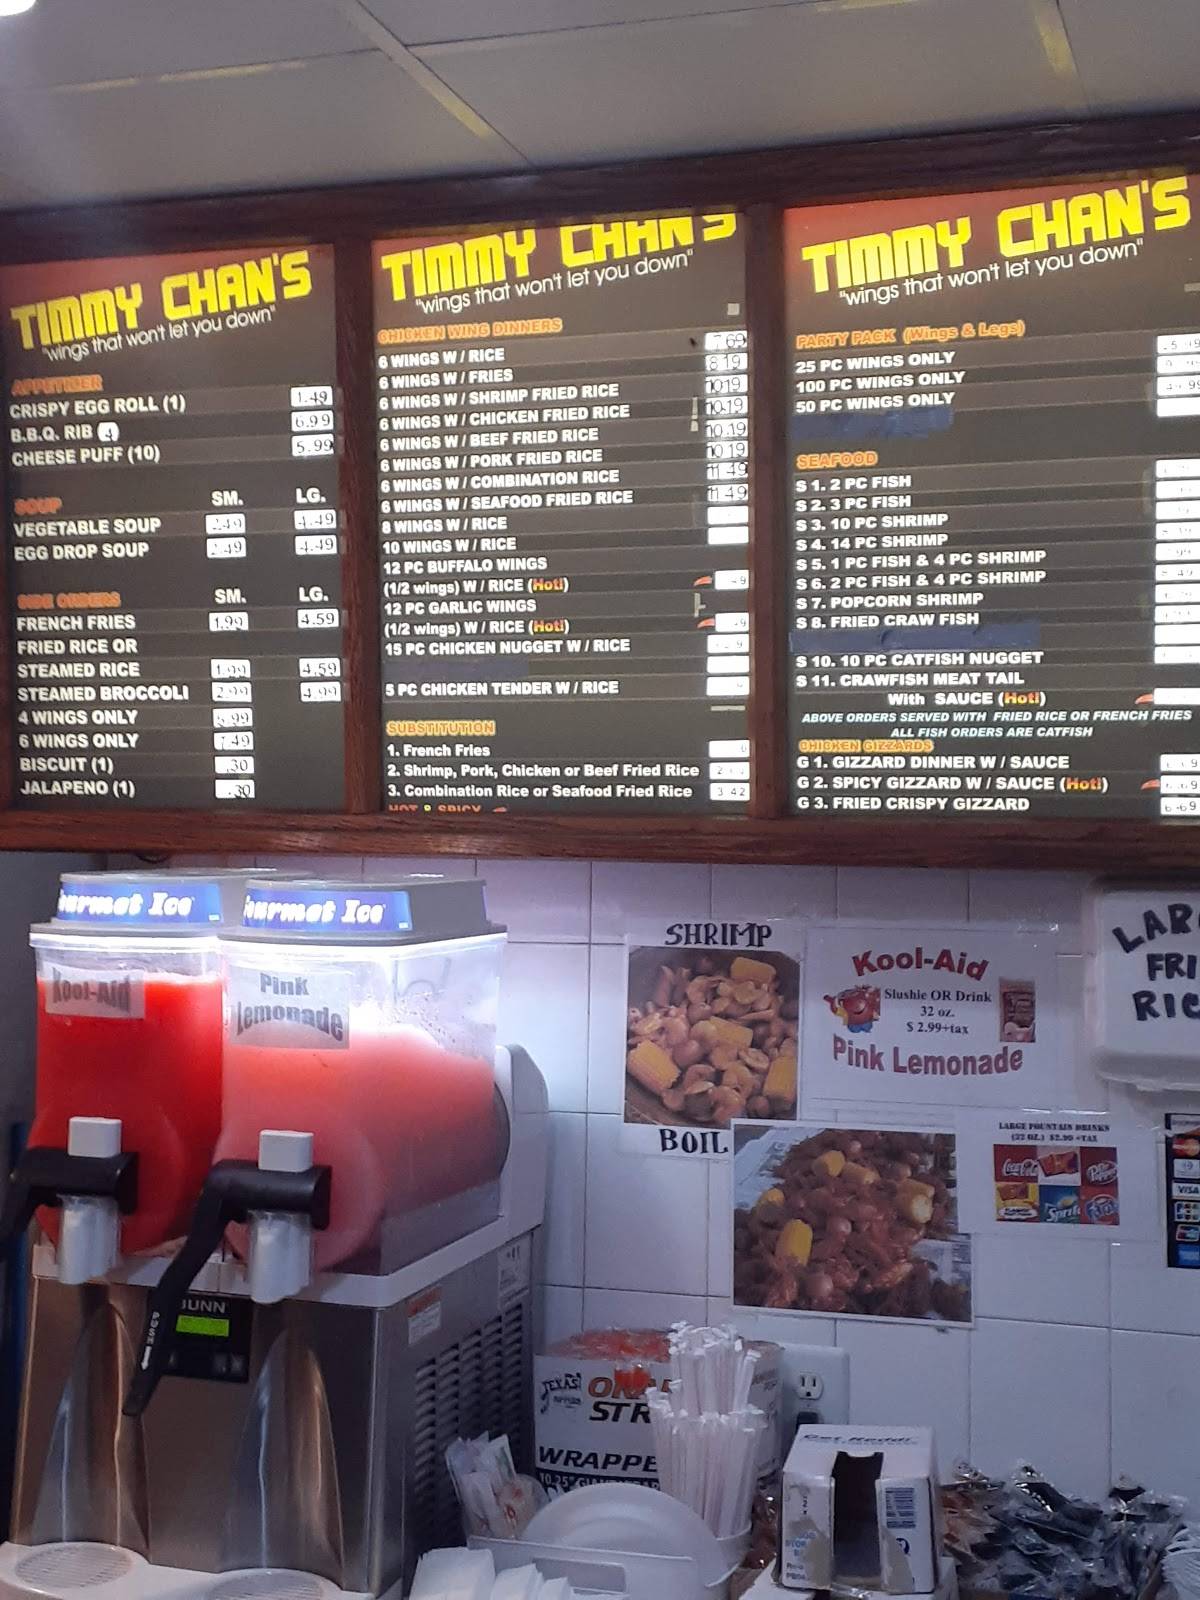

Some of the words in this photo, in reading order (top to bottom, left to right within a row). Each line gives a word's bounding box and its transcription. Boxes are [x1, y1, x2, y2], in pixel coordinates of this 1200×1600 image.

[802, 215, 972, 293] TIMMY
[997, 176, 1191, 258] CHAN'S
[381, 228, 537, 301] TIMMY
[560, 213, 736, 268] CHANS
[415, 291, 471, 315] "wings
[474, 284, 511, 306] that
[515, 272, 563, 299] won't
[567, 265, 590, 289] let
[594, 264, 630, 288] you
[635, 248, 694, 276] down"
[839, 282, 899, 307] "wings
[903, 273, 944, 298] that
[948, 262, 1000, 290] won't
[1004, 255, 1032, 279] let
[1035, 254, 1074, 278] you
[1078, 238, 1144, 267] down"
[10, 283, 143, 350] TIMMY
[161, 250, 313, 321] CHAN'S
[91, 333, 123, 354] that
[126, 323, 166, 347] won't
[169, 319, 192, 340] let
[192, 316, 223, 338] you
[226, 307, 276, 329] down"
[377, 326, 446, 345] CHICKEN
[448, 323, 490, 341] WING
[493, 318, 564, 339] DINNERS
[796, 332, 849, 350] PARTY
[851, 327, 896, 345] PACK
[903, 323, 958, 345] (Wings
[961, 322, 976, 338] &
[978, 319, 1026, 341] Legs)
[795, 360, 816, 374] 25
[819, 358, 842, 372] PC
[846, 354, 904, 370] WINGS
[908, 351, 955, 366] ONLY
[10, 401, 69, 418] CRISPY
[74, 398, 110, 415] EGG
[114, 396, 159, 413] ROLL
[162, 394, 185, 414] (1)
[11, 426, 59, 442] B.B.Q.
[64, 423, 93, 440] RIB
[12, 449, 76, 466] CHEESE
[80, 446, 123, 463] PUFF
[127, 444, 160, 464] (10)
[296, 438, 333, 454] 5.99
[795, 450, 878, 469] SEAFOOD
[211, 490, 244, 506] SM.
[296, 487, 326, 504] LG.
[14, 519, 110, 537] VEGETABLE
[113, 517, 161, 534] SOUP
[14, 545, 48, 560] EGG
[52, 543, 98, 559] DROP
[102, 541, 149, 558] SOUP
[383, 561, 401, 575] 12
[404, 560, 424, 574] PC
[427, 558, 493, 573] BUFFALO
[496, 556, 547, 571] WINGS
[215, 588, 247, 604] SM.
[299, 586, 329, 602] LG.
[796, 597, 807, 610] S
[811, 597, 826, 609] 7.
[830, 594, 911, 609] POPCORN
[916, 592, 983, 606] SHRIMP
[384, 602, 401, 615] 12
[405, 602, 425, 615] PC
[428, 600, 483, 614] GARLIC
[486, 599, 536, 613] WINGS
[17, 615, 83, 631] FRENCH
[87, 614, 136, 630] FRIES
[301, 613, 335, 626] 4.59
[17, 640, 65, 654] FRIED
[69, 638, 109, 654] RICE
[112, 638, 138, 653] OR
[18, 662, 95, 678] STEAMED
[99, 662, 140, 677] RICE
[303, 662, 337, 677] 4.59
[18, 686, 96, 701] STEAMED
[100, 685, 189, 701] BROCCOLI
[18, 711, 28, 724] 4
[32, 710, 88, 725] WINGS
[91, 709, 138, 724] ONLY
[386, 720, 496, 736] SUBSTITUTION
[890, 727, 914, 737] ALL
[917, 727, 948, 737] FISH
[950, 727, 1003, 737] ORDERS
[1006, 727, 1033, 737] ARE
[1036, 726, 1093, 737] CATFISH
[387, 743, 400, 756] 1.
[403, 743, 451, 757] French
[455, 743, 490, 756] Fries
[798, 738, 862, 753] CHICKEN
[862, 738, 934, 753] GIZZARDS
[20, 756, 87, 771] BISCUIT
[91, 756, 113, 775] (1)
[387, 763, 400, 776] 2.
[403, 764, 457, 779] Shrimp,
[460, 764, 498, 779] Pork,
[501, 763, 560, 777] Chicken
[564, 766, 580, 776] or
[583, 763, 619, 777] Beef
[622, 763, 661, 776] Fried
[665, 763, 699, 776] Rice
[797, 796, 809, 809] G
[814, 796, 828, 809] 3.
[833, 796, 881, 809] FRIED
[885, 797, 948, 810] CRISPY
[952, 797, 1029, 811] GIZZARD
[665, 922, 773, 948] SHRIMP
[1112, 903, 1200, 954] LAR
[851, 947, 990, 982] Kool-Aid
[53, 967, 131, 1012] Kool-Aid
[260, 973, 310, 996] Pink
[884, 988, 927, 1001] Slushie
[930, 989, 953, 1001] OR
[955, 990, 992, 1003] Drink
[920, 1006, 935, 1017] 32
[938, 1009, 955, 1018] oz.
[906, 1022, 914, 1032] $
[917, 1022, 969, 1035] 2.99+tax
[833, 1033, 885, 1071] Pink
[893, 1046, 1023, 1076] Lemonade
[659, 1128, 729, 1154] BOIL
[1178, 1185, 1200, 1194] VISA
[182, 1299, 226, 1314] UNN
[147, 1311, 160, 1345] PUSH
